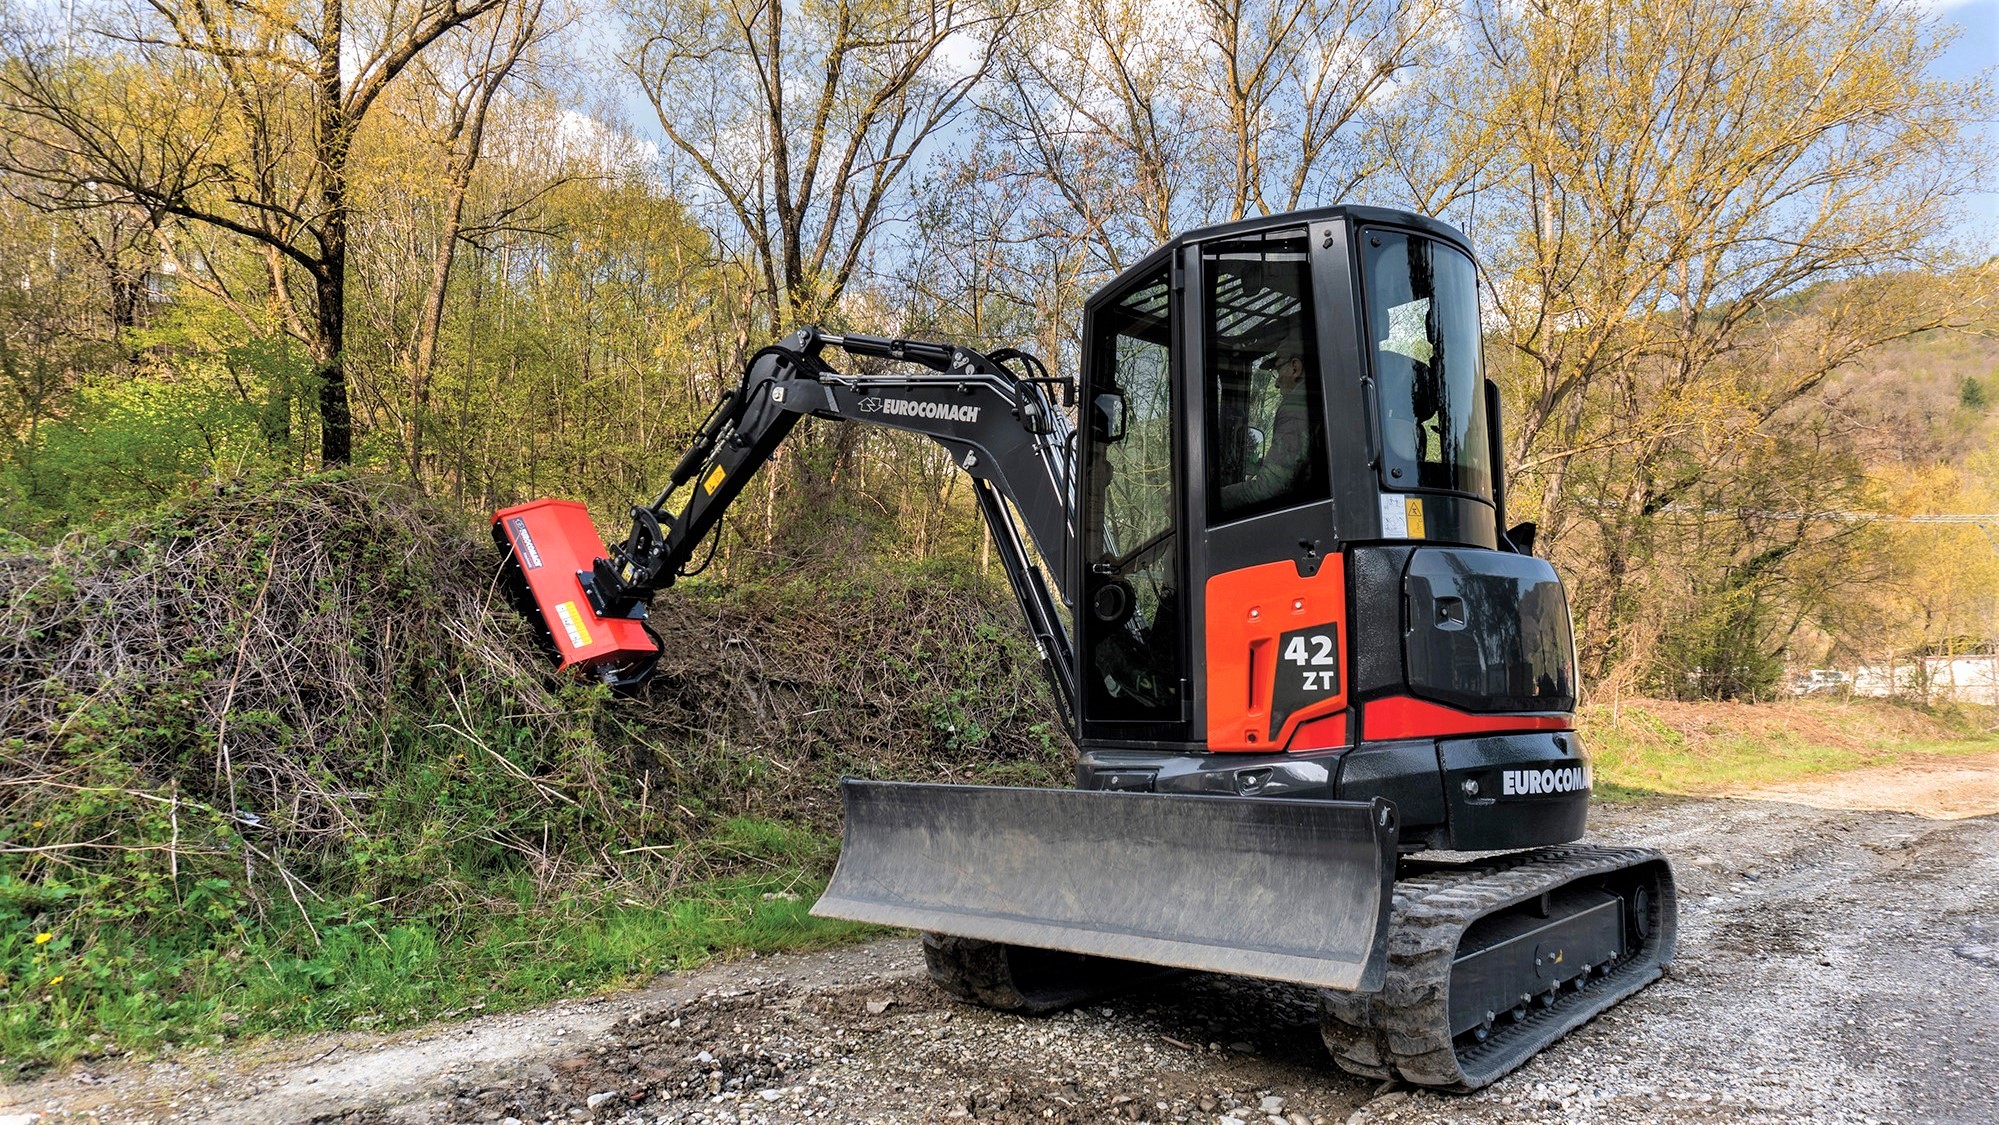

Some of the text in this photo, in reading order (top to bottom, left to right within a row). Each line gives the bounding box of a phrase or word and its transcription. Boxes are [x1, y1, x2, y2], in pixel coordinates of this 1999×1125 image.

[882, 398, 979, 423] EUROCOMACH
[1284, 635, 1334, 666] 42
[1302, 671, 1334, 691] ZT
[1502, 766, 1590, 796] EUROCOMA
